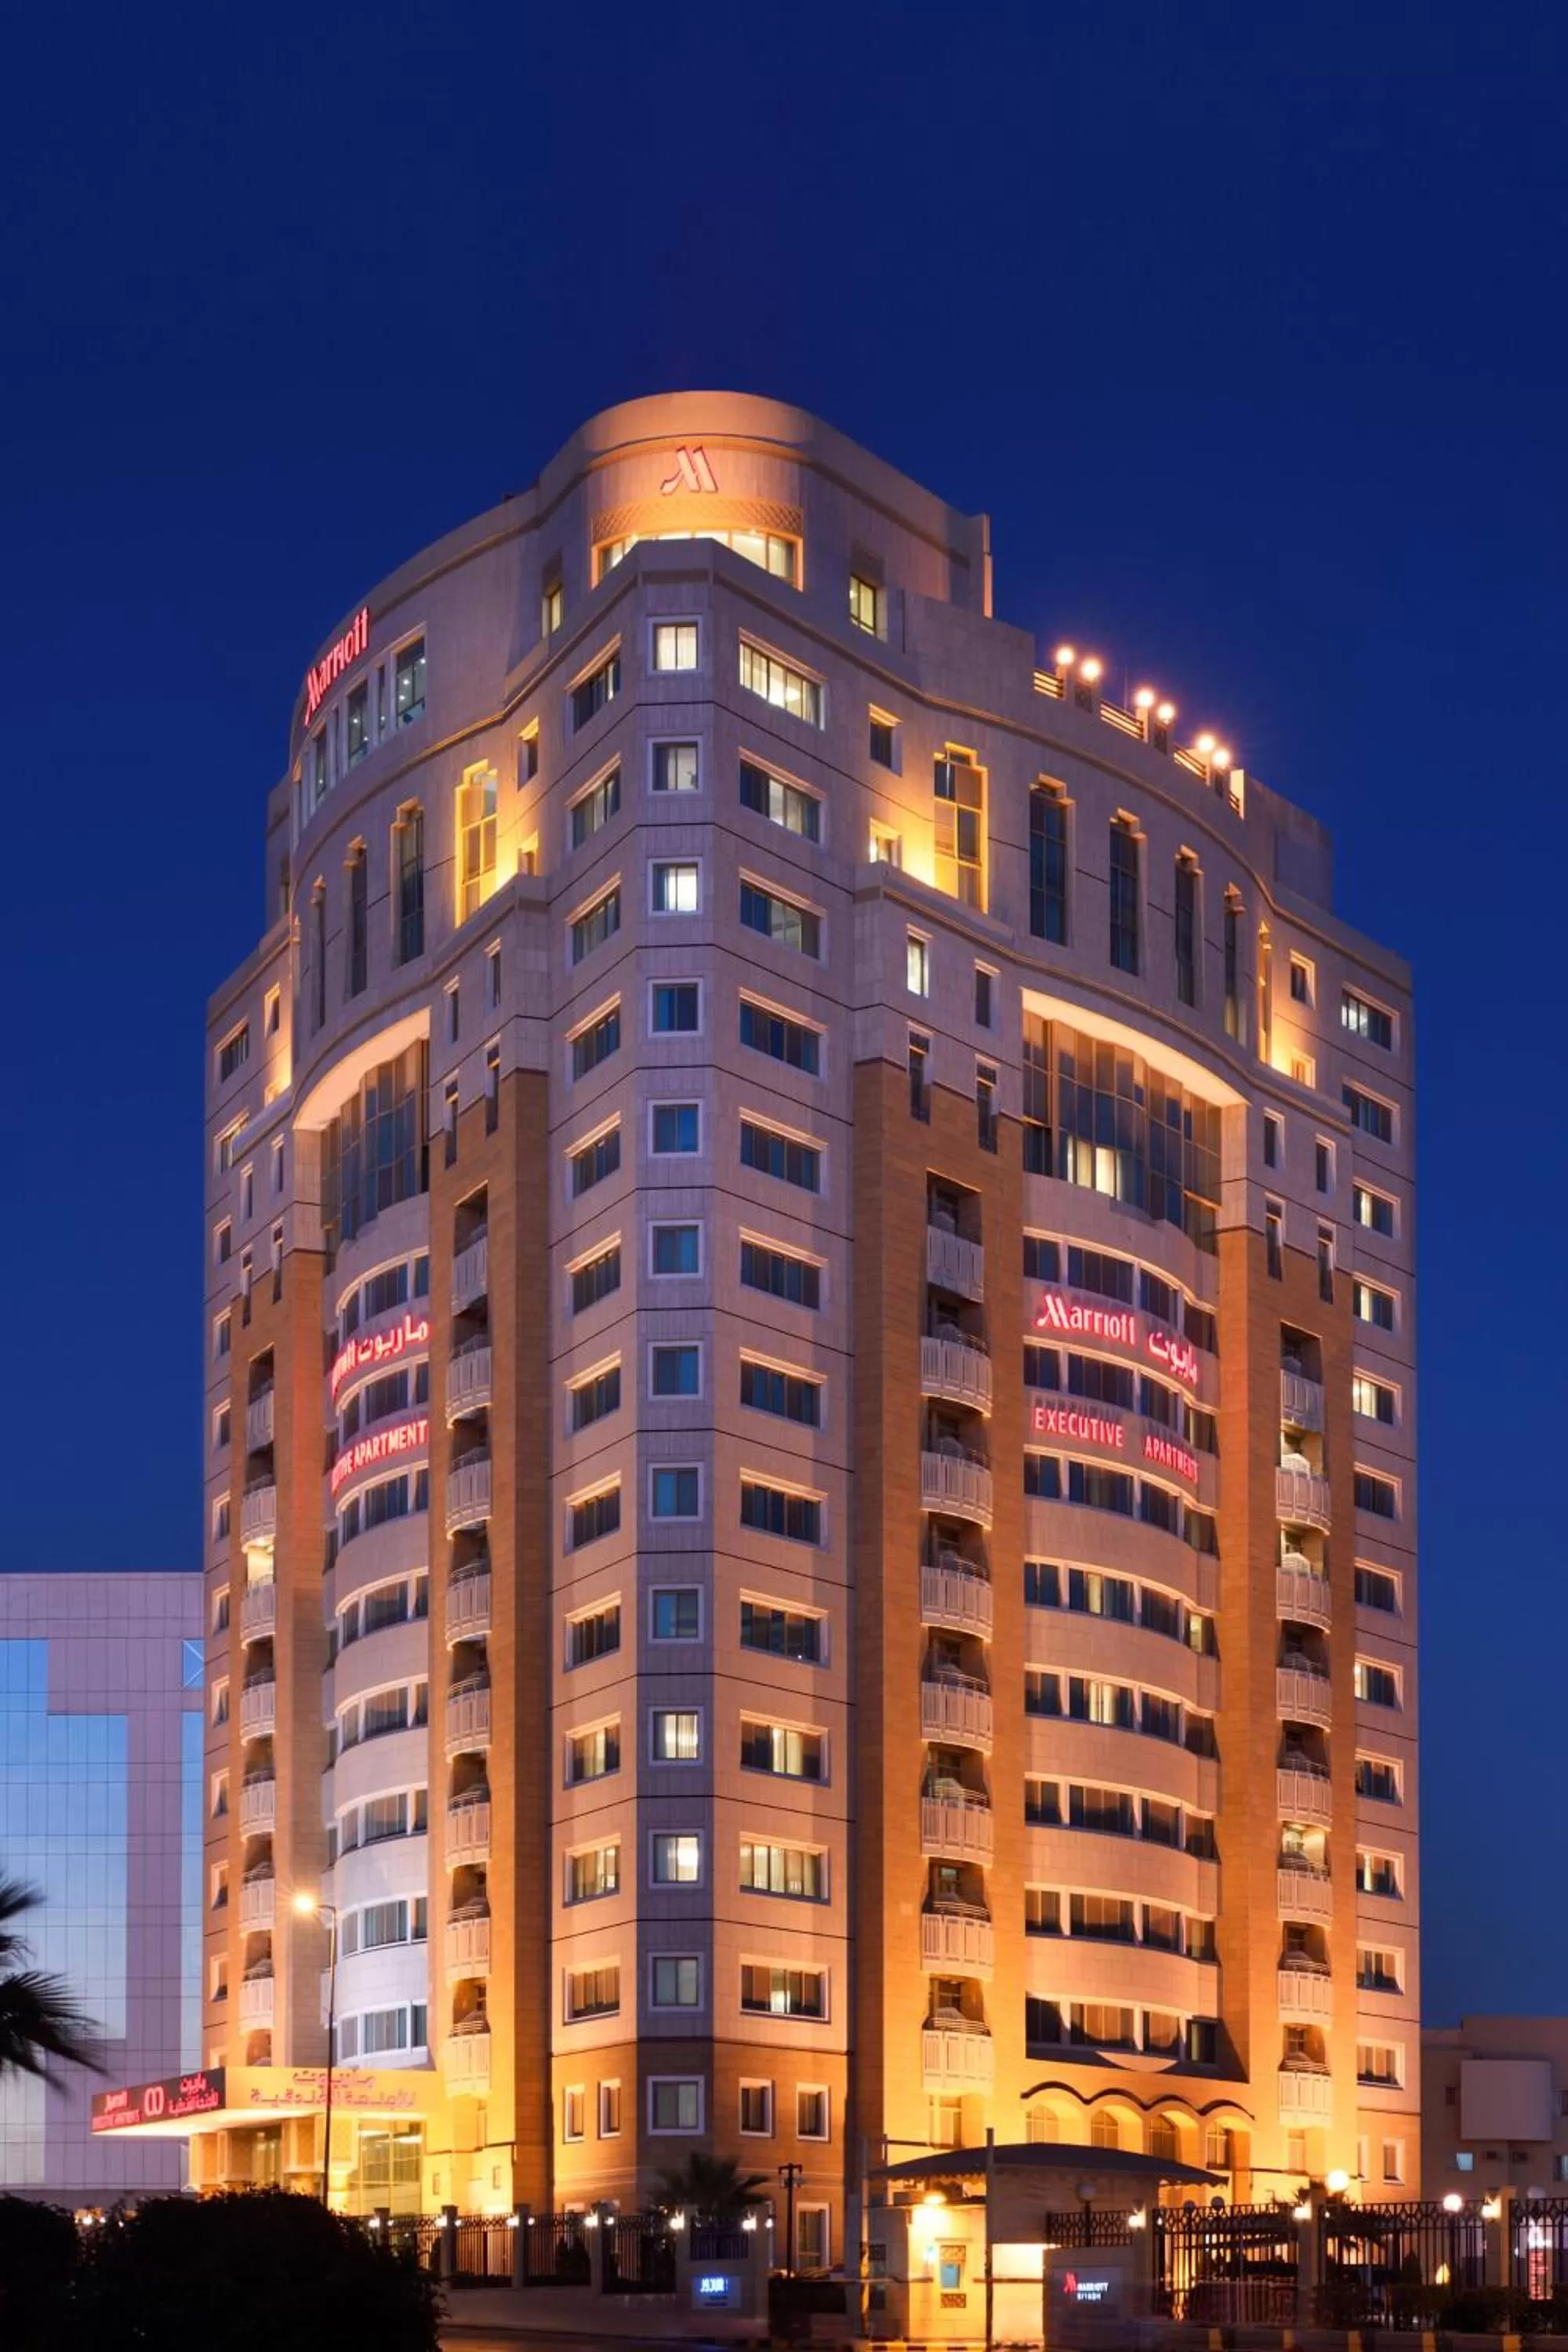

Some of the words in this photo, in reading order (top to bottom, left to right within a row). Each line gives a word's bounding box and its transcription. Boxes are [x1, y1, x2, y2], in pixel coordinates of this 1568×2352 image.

[303, 606, 368, 728] Marriott
[357, 1314, 429, 1361] ماريوت
[1035, 1293, 1137, 1345] Marriott
[1034, 1407, 1123, 1447] EXECUTIVE
